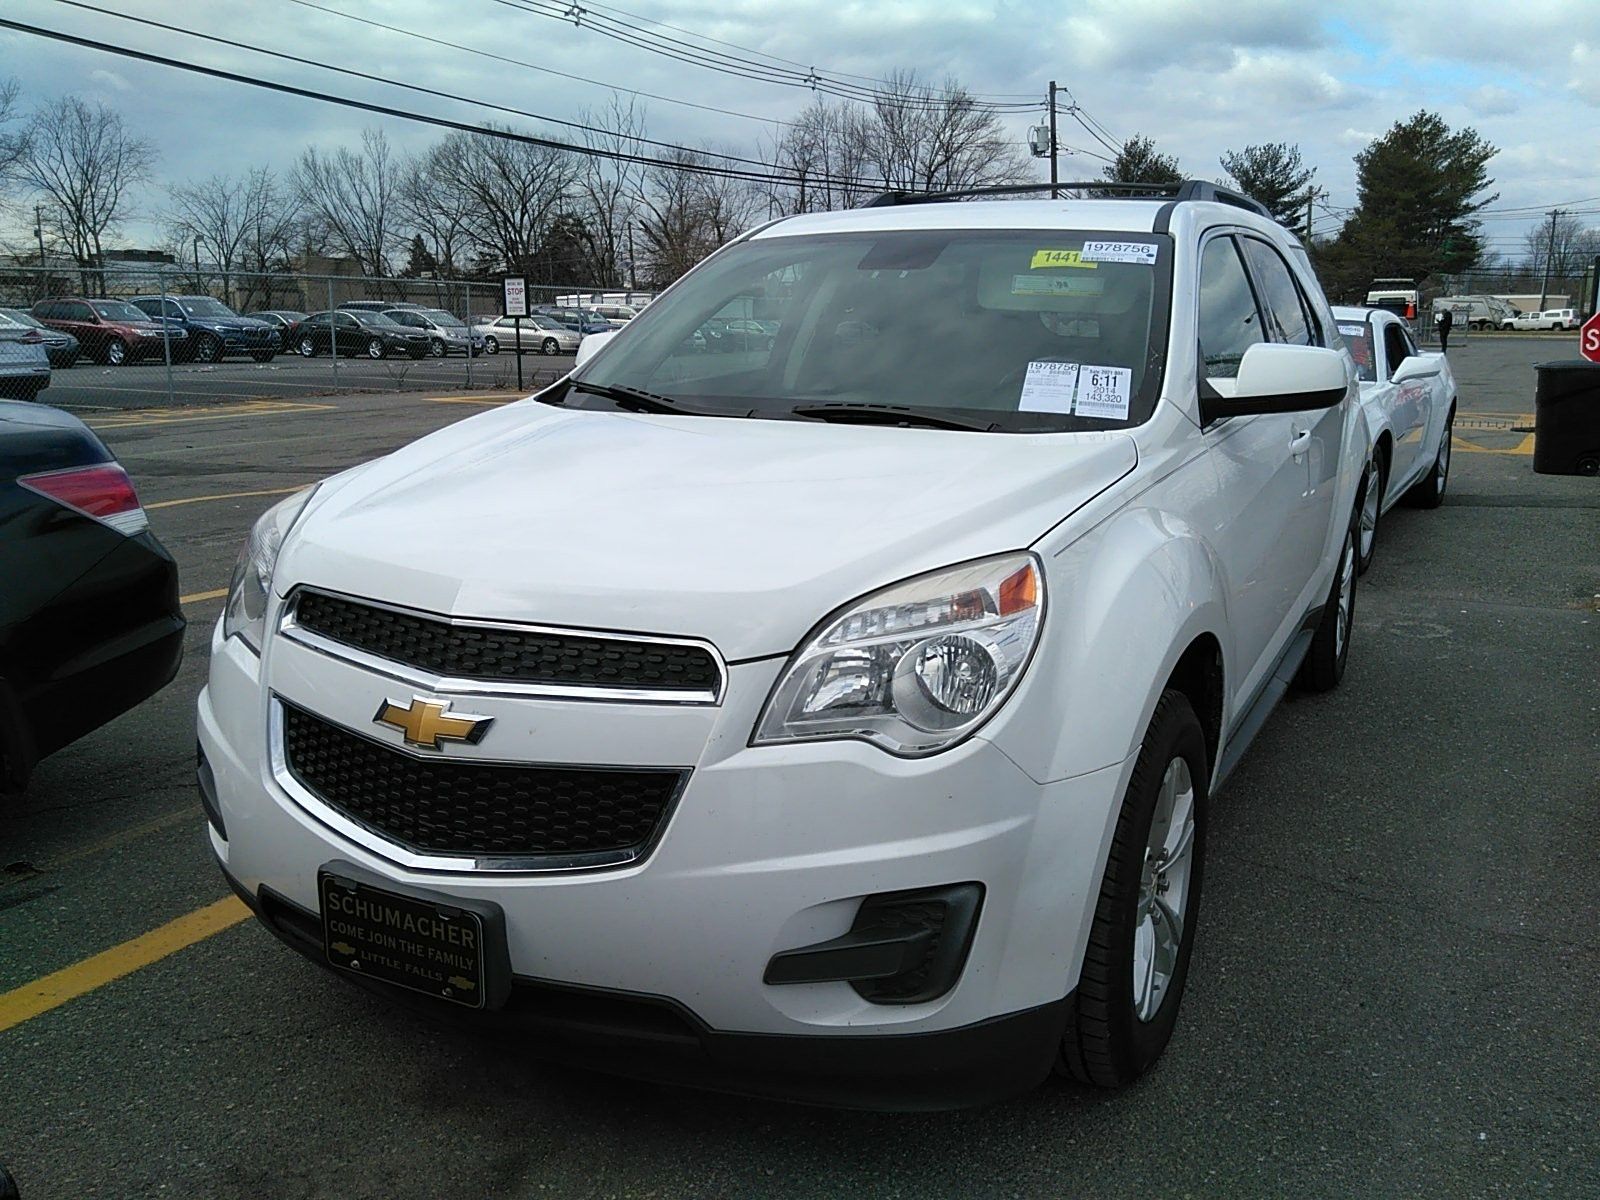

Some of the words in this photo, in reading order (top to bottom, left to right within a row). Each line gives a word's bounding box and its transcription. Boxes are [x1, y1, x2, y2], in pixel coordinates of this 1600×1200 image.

[1086, 243, 1150, 254] 1978756
[1030, 362, 1078, 372] 1978756
[1091, 374, 1117, 388] 6:11
[328, 891, 475, 949] SCHUMACHER
[330, 919, 364, 940] COME
[367, 930, 397, 949] JOIN
[399, 939, 425, 957] THE
[428, 947, 474, 972] FAMILY
[361, 950, 401, 970] LITTLE
[405, 964, 443, 982] FALLS
